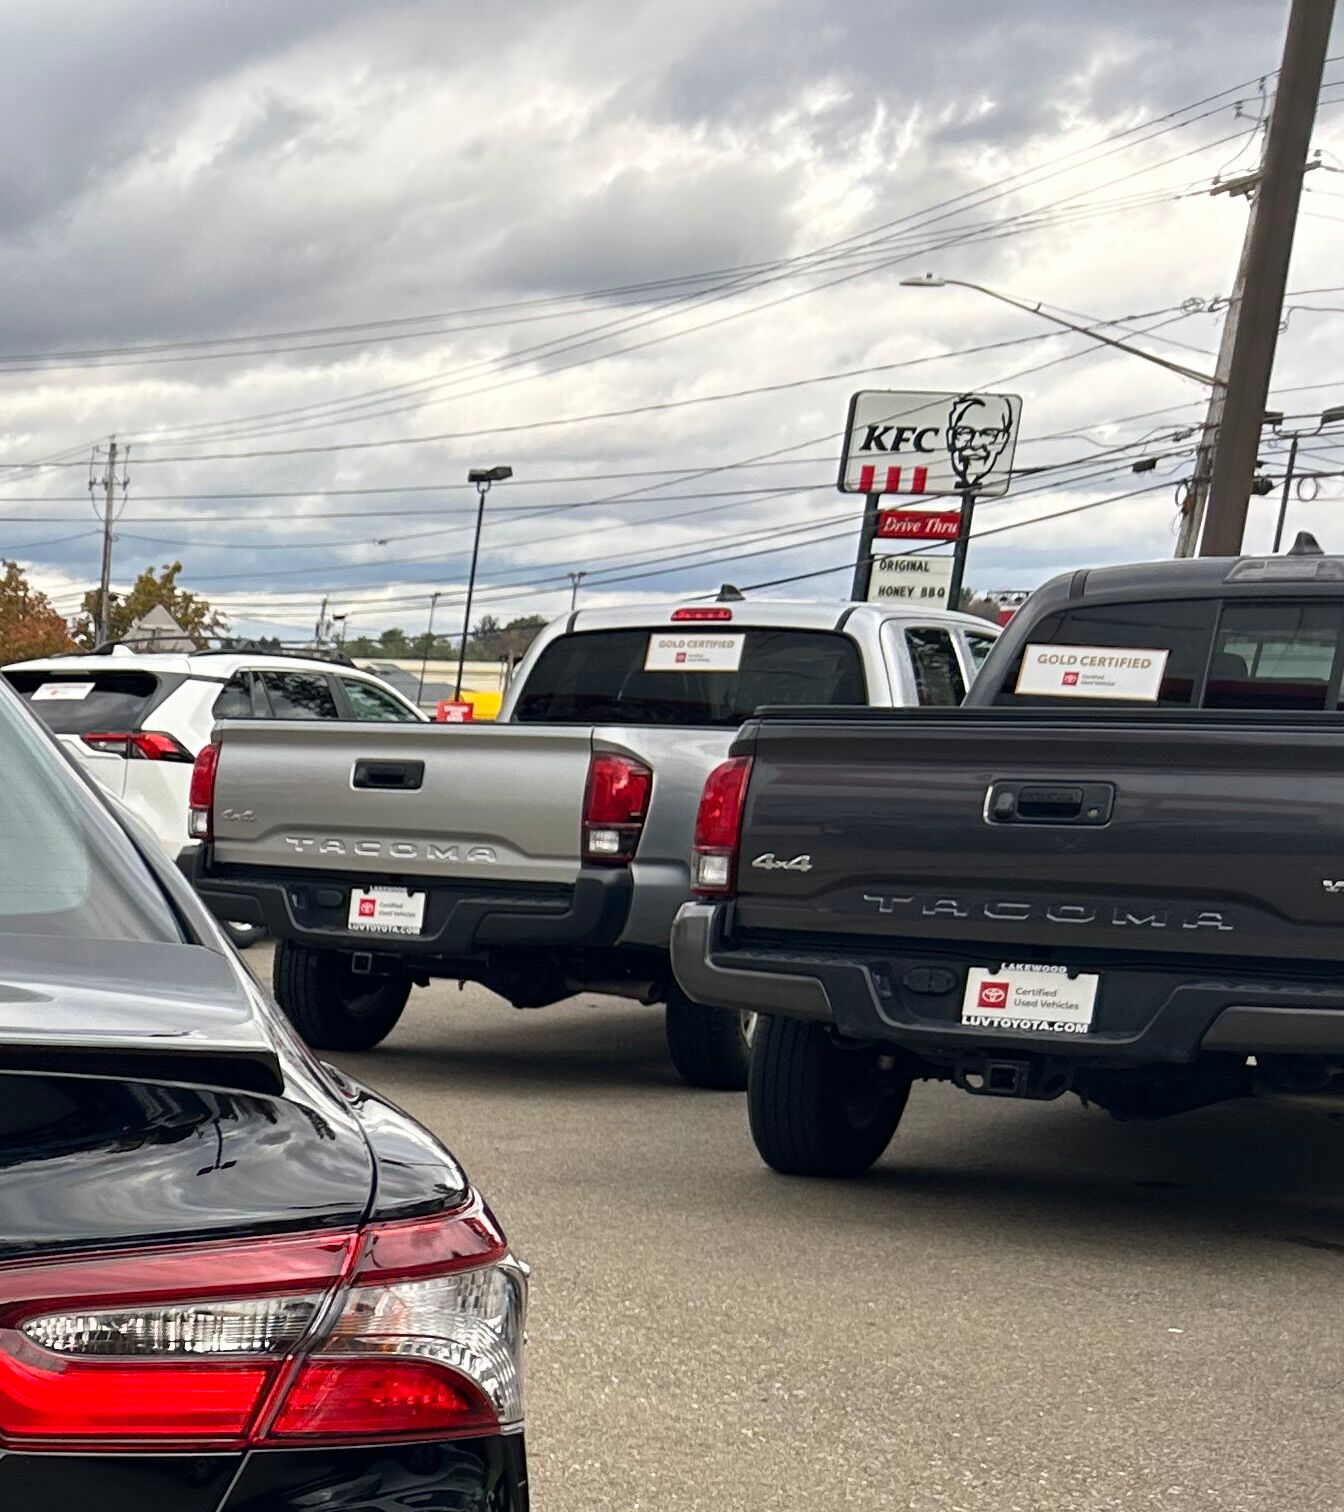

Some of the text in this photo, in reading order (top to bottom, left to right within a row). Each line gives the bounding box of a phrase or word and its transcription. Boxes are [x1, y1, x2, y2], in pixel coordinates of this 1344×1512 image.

[859, 425, 940, 453] KFC
[883, 516, 958, 534] Drive Thru
[879, 560, 929, 572] ORIGINAL
[878, 585, 946, 599] HONEY BBQ
[658, 639, 735, 649] GOLD CERTIFIED
[1037, 653, 1152, 669] GOLD CERTIFIED
[285, 837, 497, 864] TACOMA
[751, 852, 813, 872] 4x4
[863, 894, 1235, 930] TACOMA
[1000, 962, 1068, 974] LAKEWOOD
[1015, 987, 1057, 998] Certified
[1014, 999, 1080, 1011] Used Vehicles
[961, 1015, 1089, 1034] LUVTOYOTA.COM
